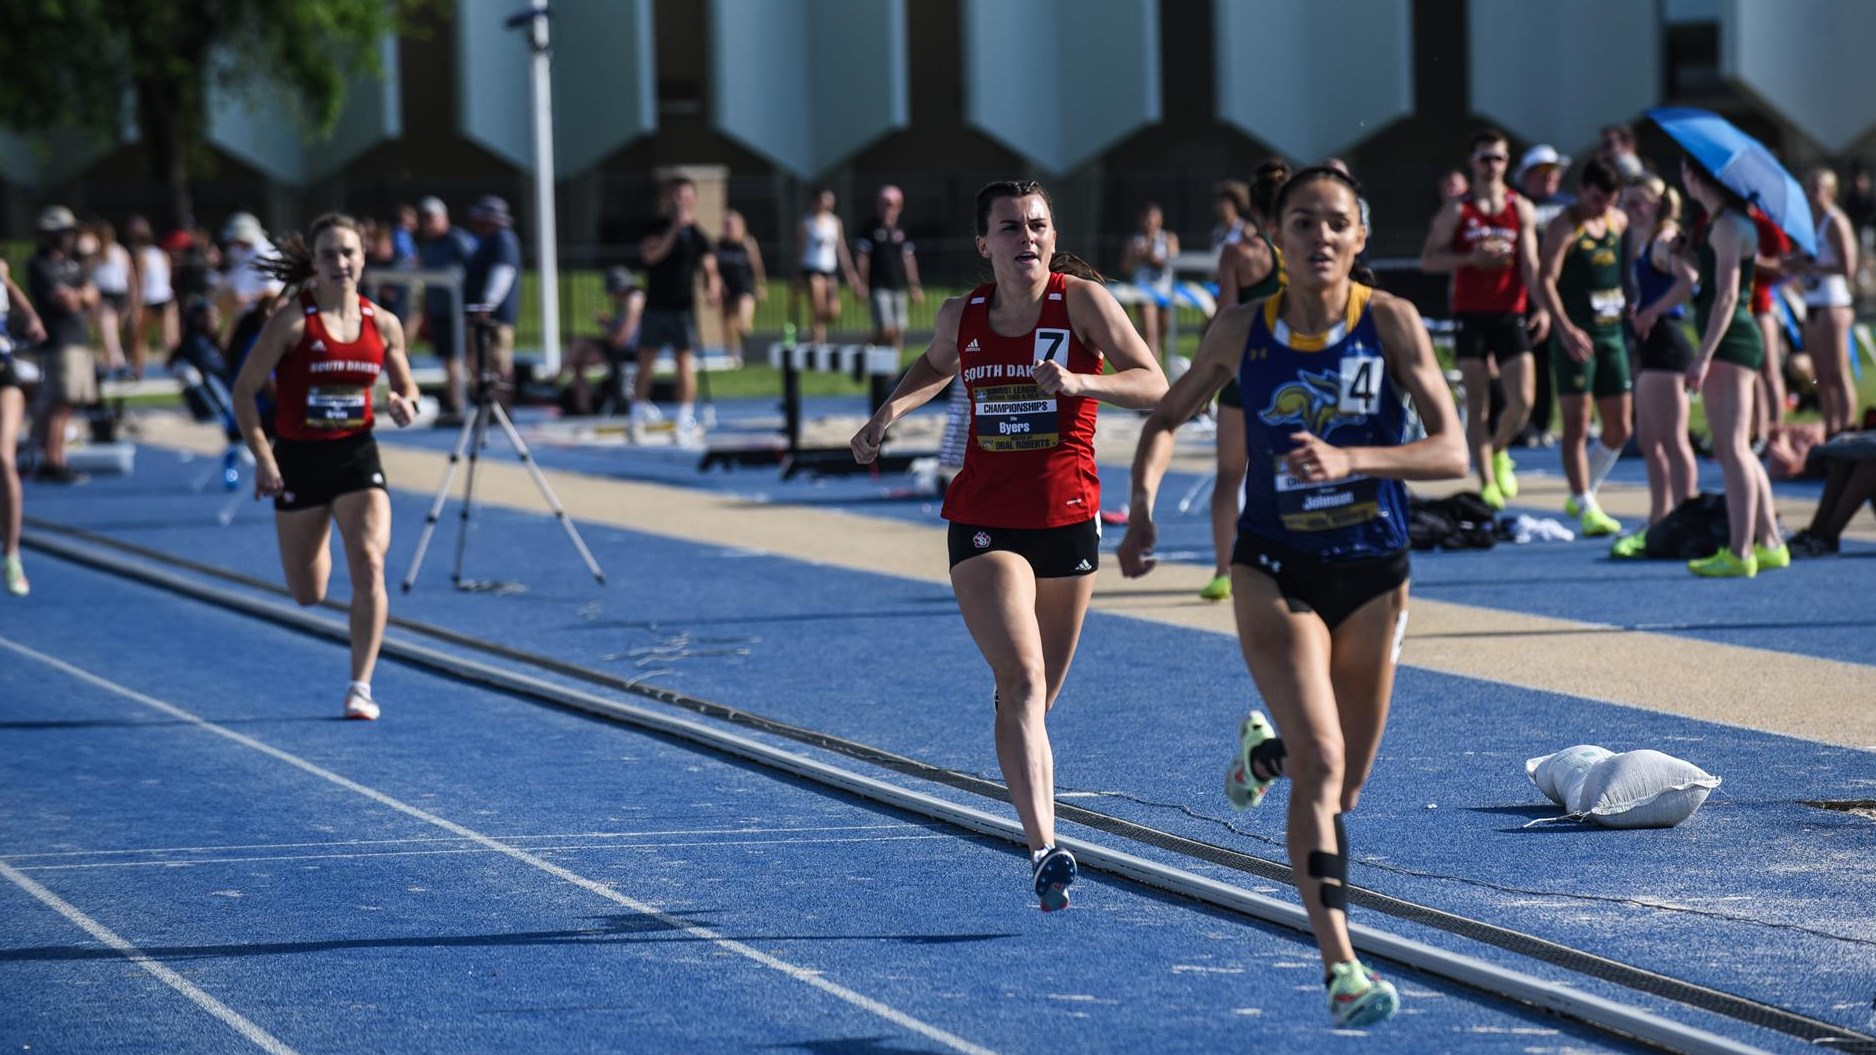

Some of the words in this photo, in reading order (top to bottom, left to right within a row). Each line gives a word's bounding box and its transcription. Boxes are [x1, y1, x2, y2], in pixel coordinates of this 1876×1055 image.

[1039, 332, 1064, 361] 7
[964, 364, 1003, 382] SOUTH
[1006, 364, 1035, 377] DAK
[1350, 361, 1374, 409] 4
[983, 401, 1048, 413] CHAMPIONSHIPS
[999, 421, 1030, 435] Byers
